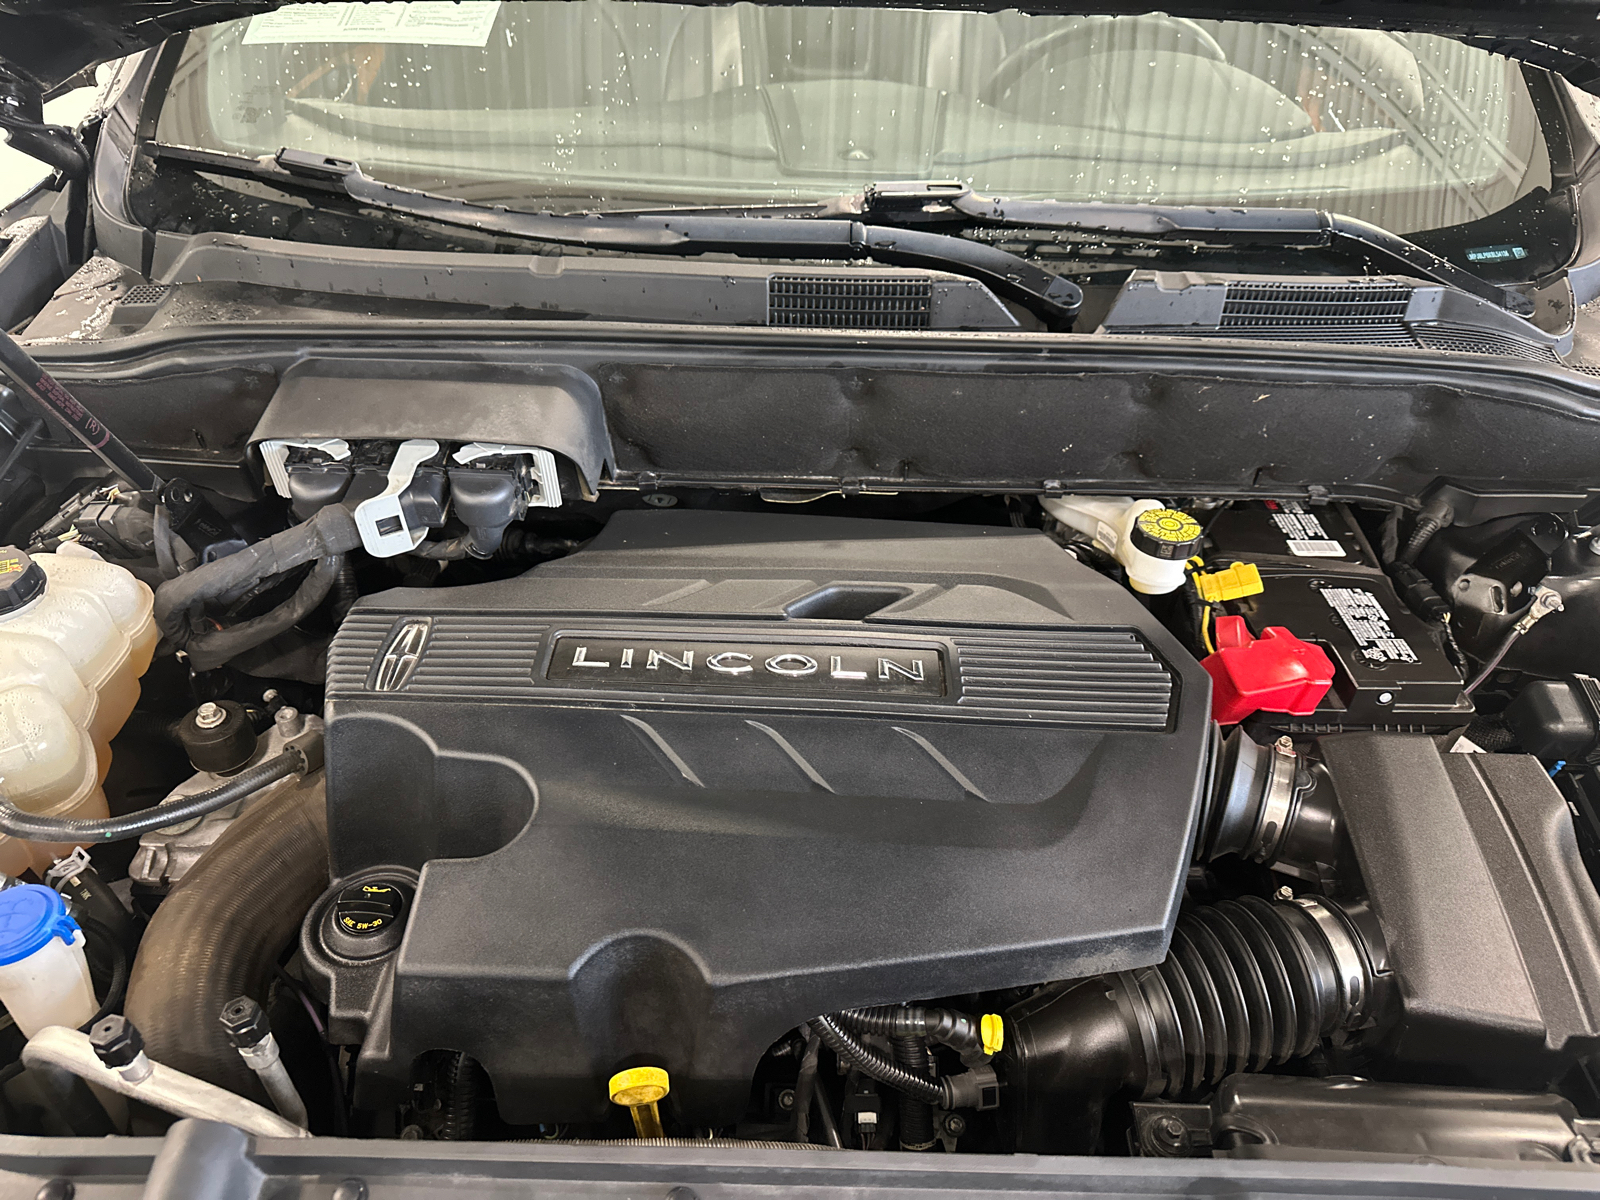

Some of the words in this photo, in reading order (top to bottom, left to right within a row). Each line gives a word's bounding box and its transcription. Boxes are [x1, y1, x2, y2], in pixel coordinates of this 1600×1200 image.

[571, 646, 925, 682] LINCOLN
[343, 916, 356, 928] SAE
[356, 918, 383, 930] 5W-30
